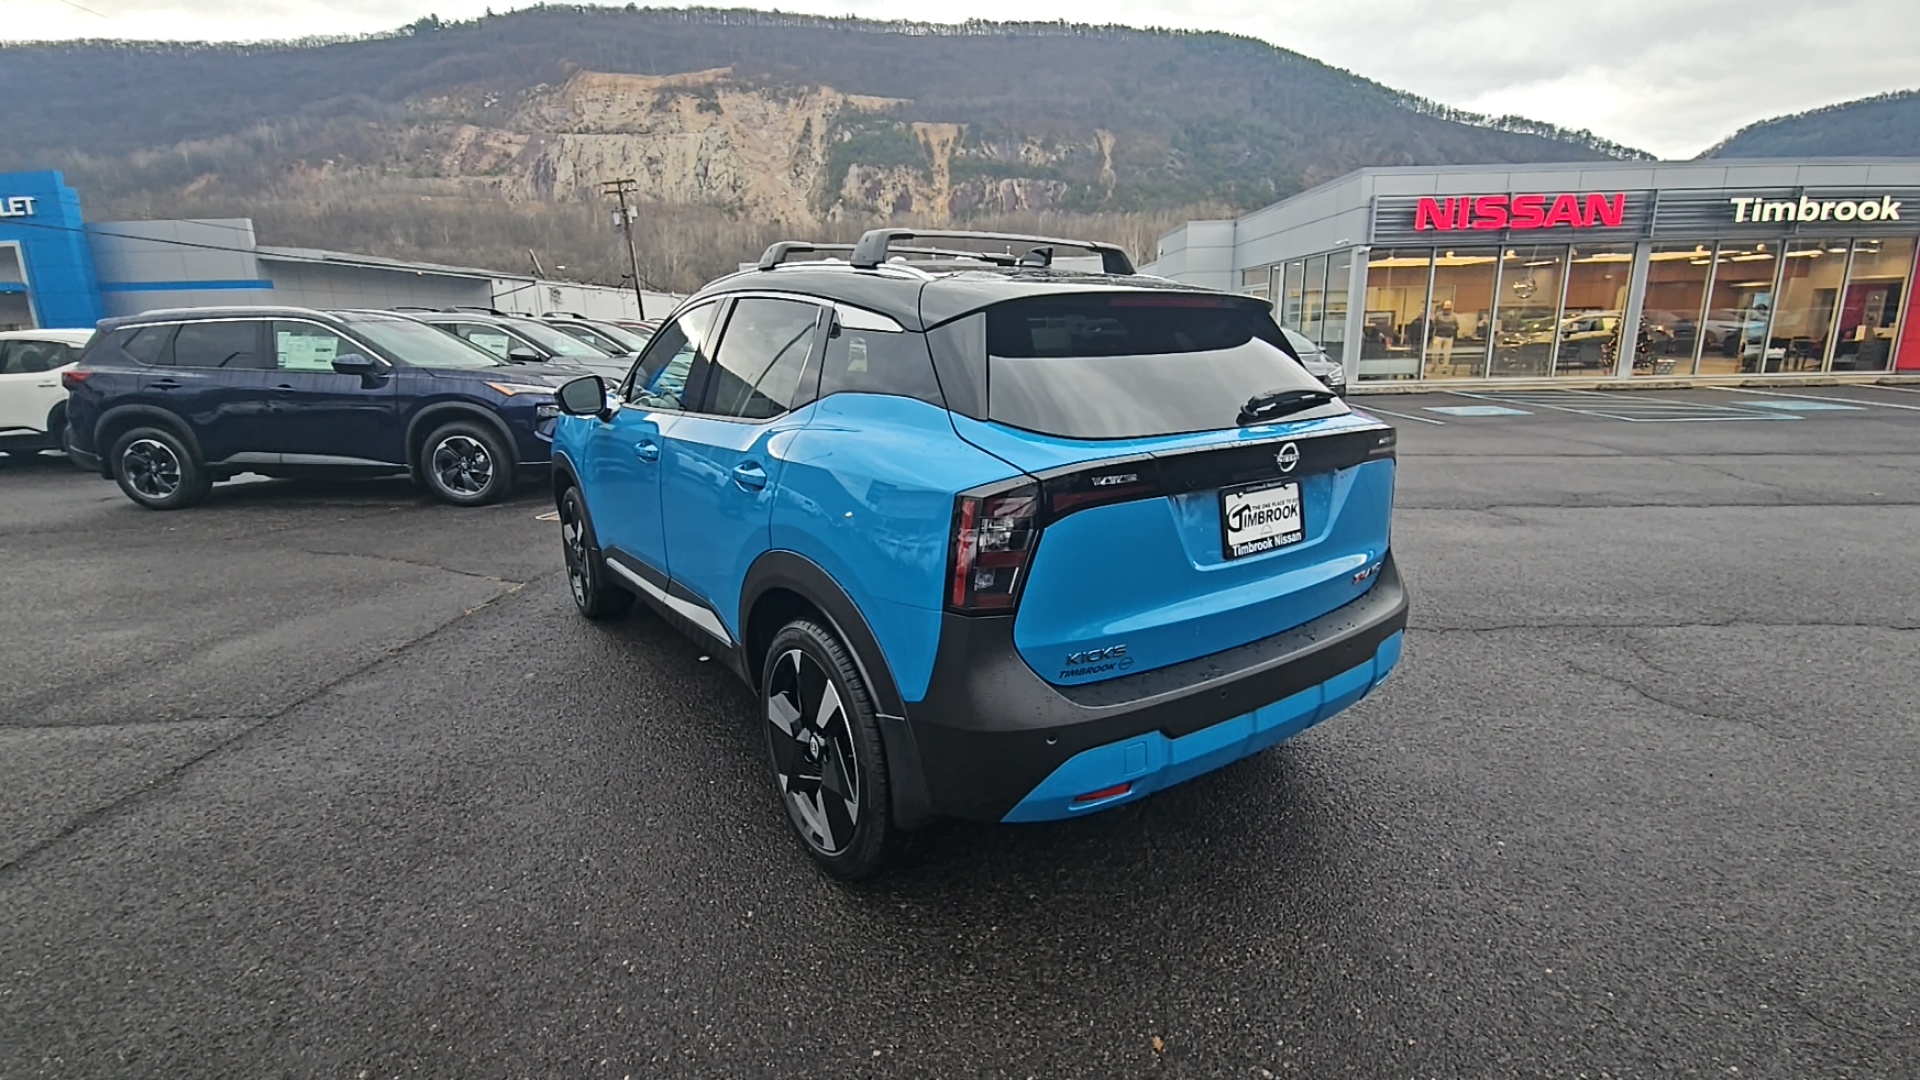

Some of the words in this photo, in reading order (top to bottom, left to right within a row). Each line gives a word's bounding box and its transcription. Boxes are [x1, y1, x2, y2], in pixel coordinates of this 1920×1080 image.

[0, 196, 35, 217] LET
[1414, 193, 1626, 231] NISSAN
[1730, 195, 1902, 223] Timbrook
[1227, 504, 1298, 532] TIMBROOK
[1232, 538, 1273, 556] Timbrook
[1274, 532, 1301, 546] Nissan
[1067, 644, 1126, 665] KICKS
[1059, 662, 1117, 678] TIMBROOK
